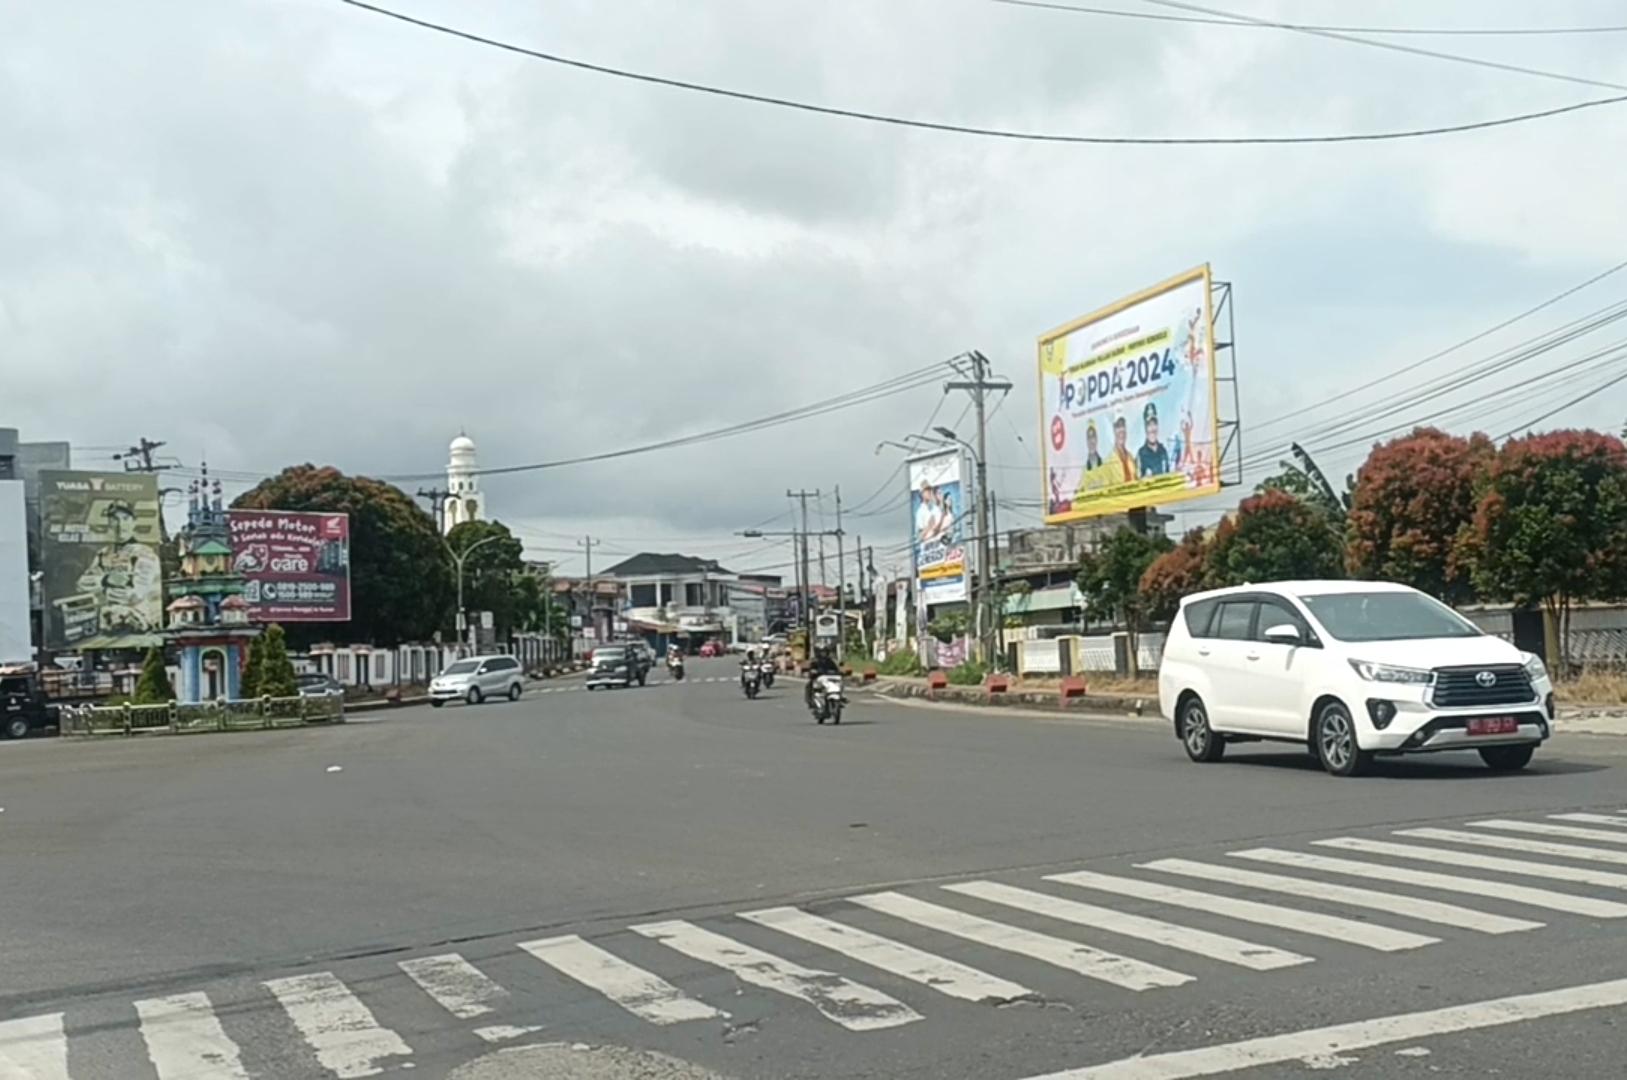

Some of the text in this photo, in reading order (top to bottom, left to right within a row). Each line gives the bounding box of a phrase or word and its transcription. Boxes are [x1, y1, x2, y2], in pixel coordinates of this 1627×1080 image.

[1126, 347, 1175, 389] 2024
[230, 517, 316, 533] Sepeda Motor
